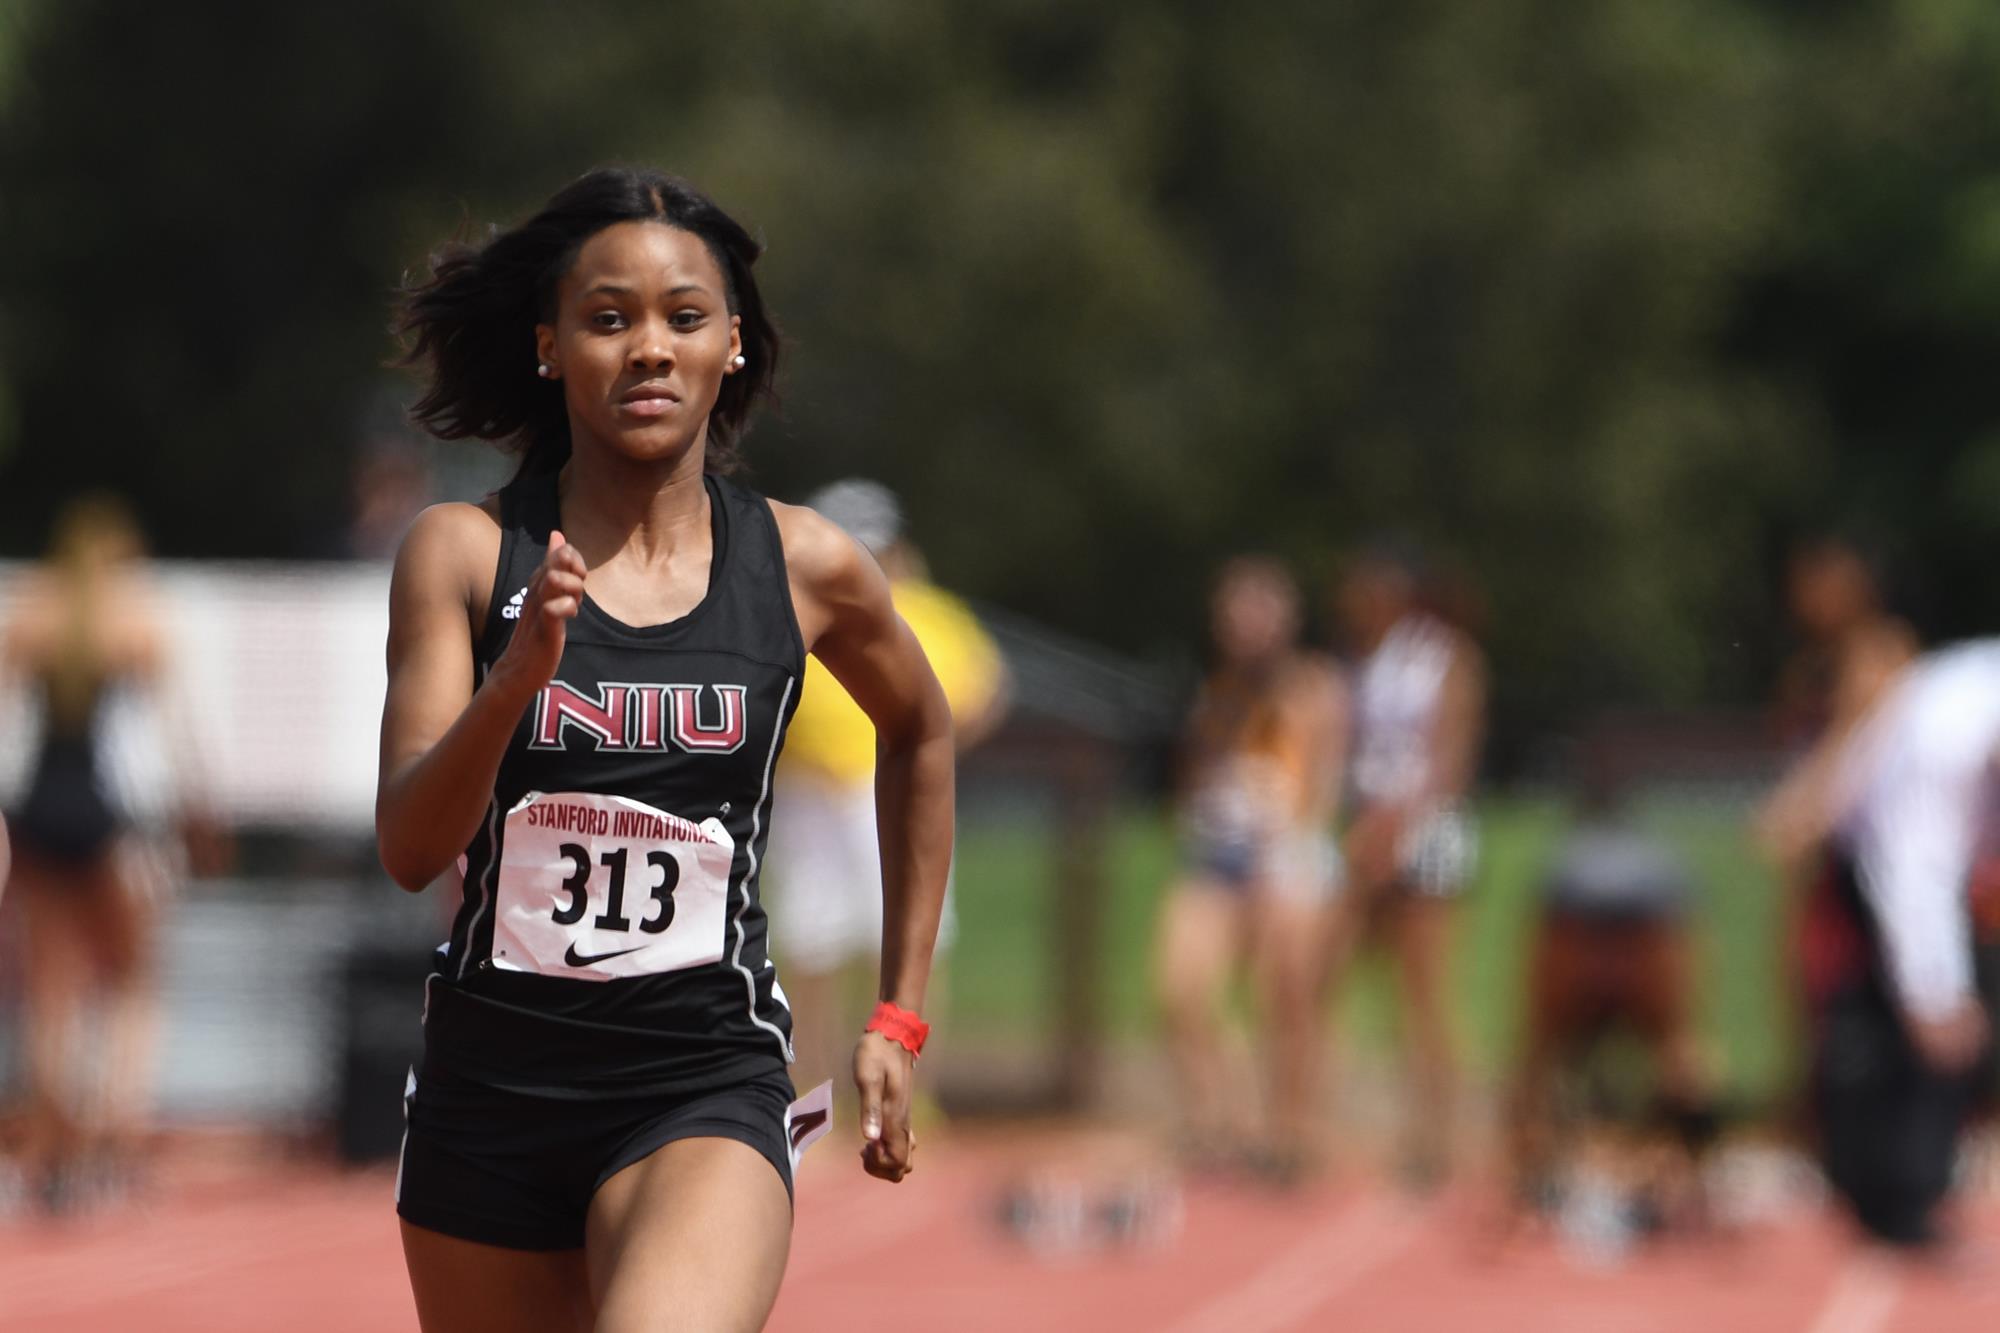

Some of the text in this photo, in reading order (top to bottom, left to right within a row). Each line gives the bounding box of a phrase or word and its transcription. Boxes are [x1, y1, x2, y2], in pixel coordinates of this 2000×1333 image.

[527, 679, 748, 755] NIU
[527, 803, 718, 845] STANFORD INVITATION
[551, 842, 680, 934] 313
